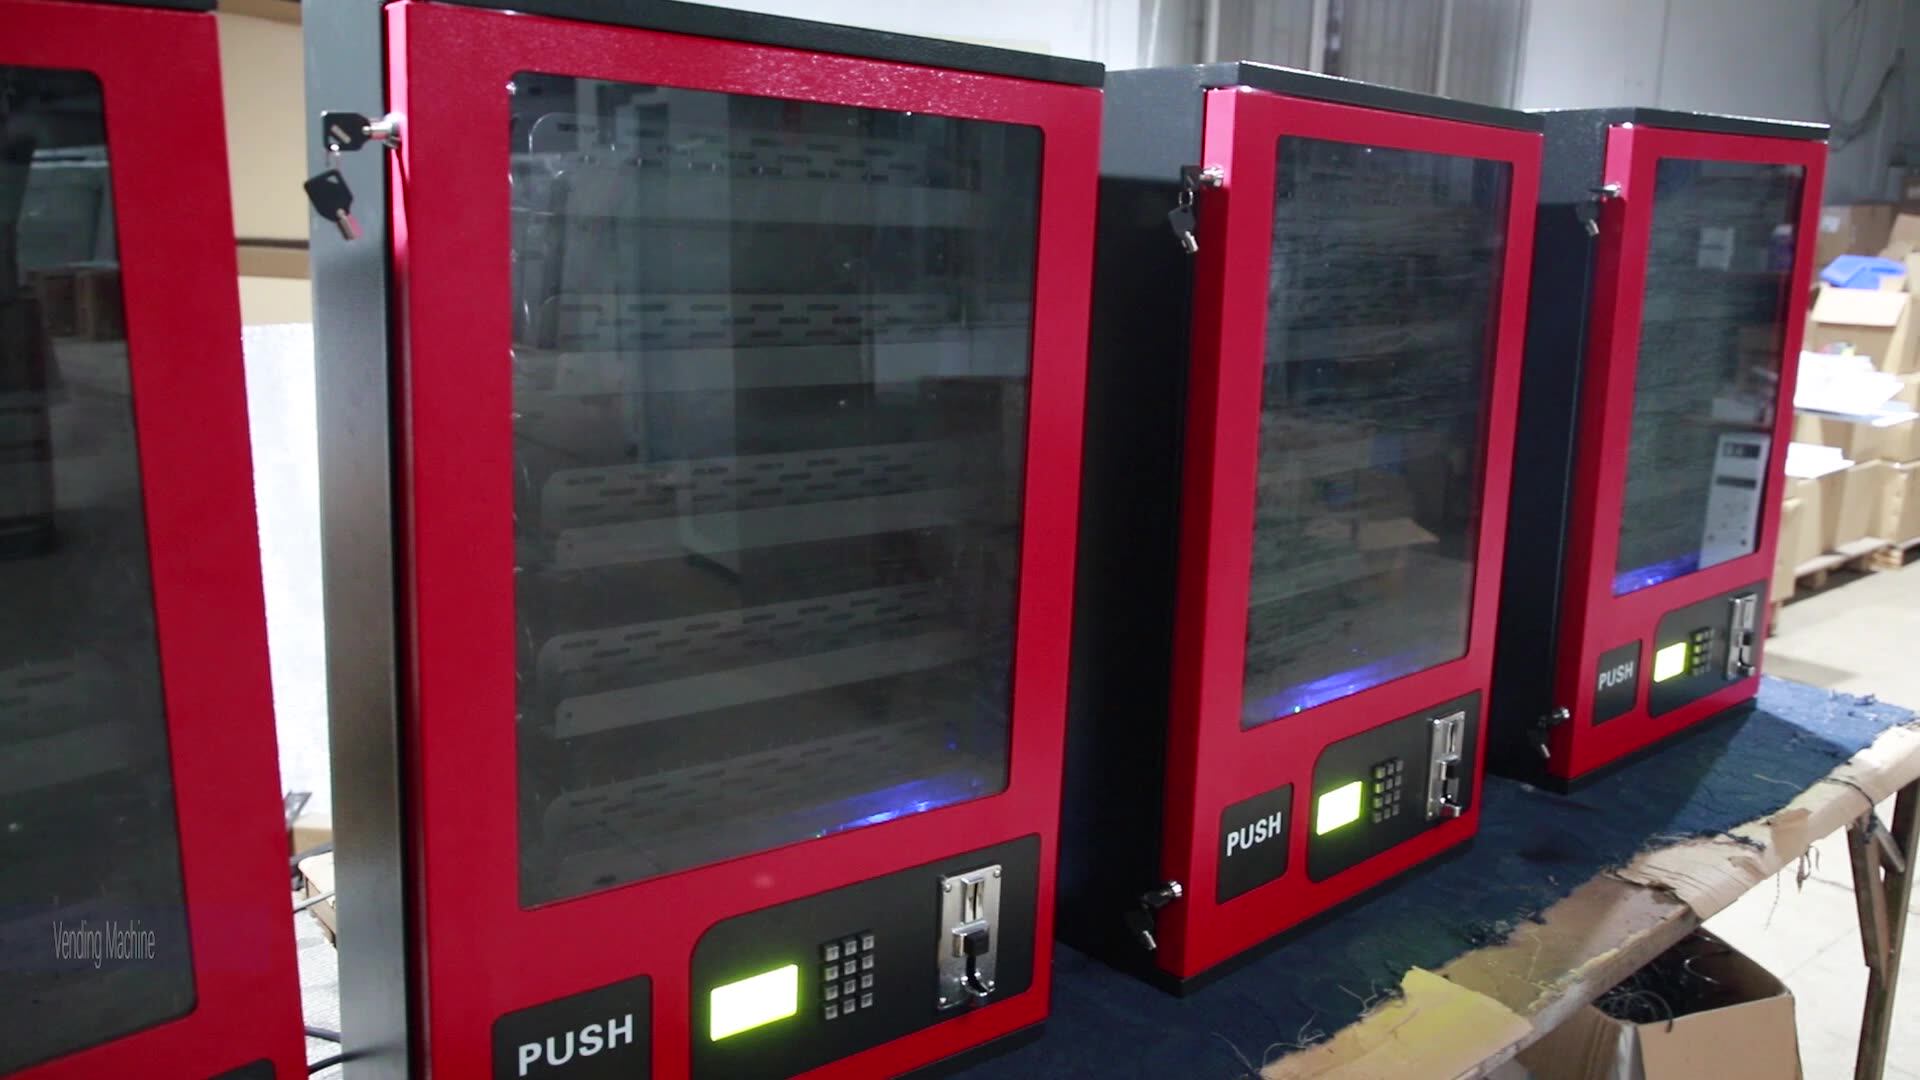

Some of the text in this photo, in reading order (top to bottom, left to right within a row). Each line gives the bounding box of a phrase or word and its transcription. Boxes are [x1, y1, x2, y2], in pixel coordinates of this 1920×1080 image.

[1598, 660, 1634, 691] PUSH
[1226, 811, 1282, 857] PUSH
[518, 1014, 633, 1077] PUSH
